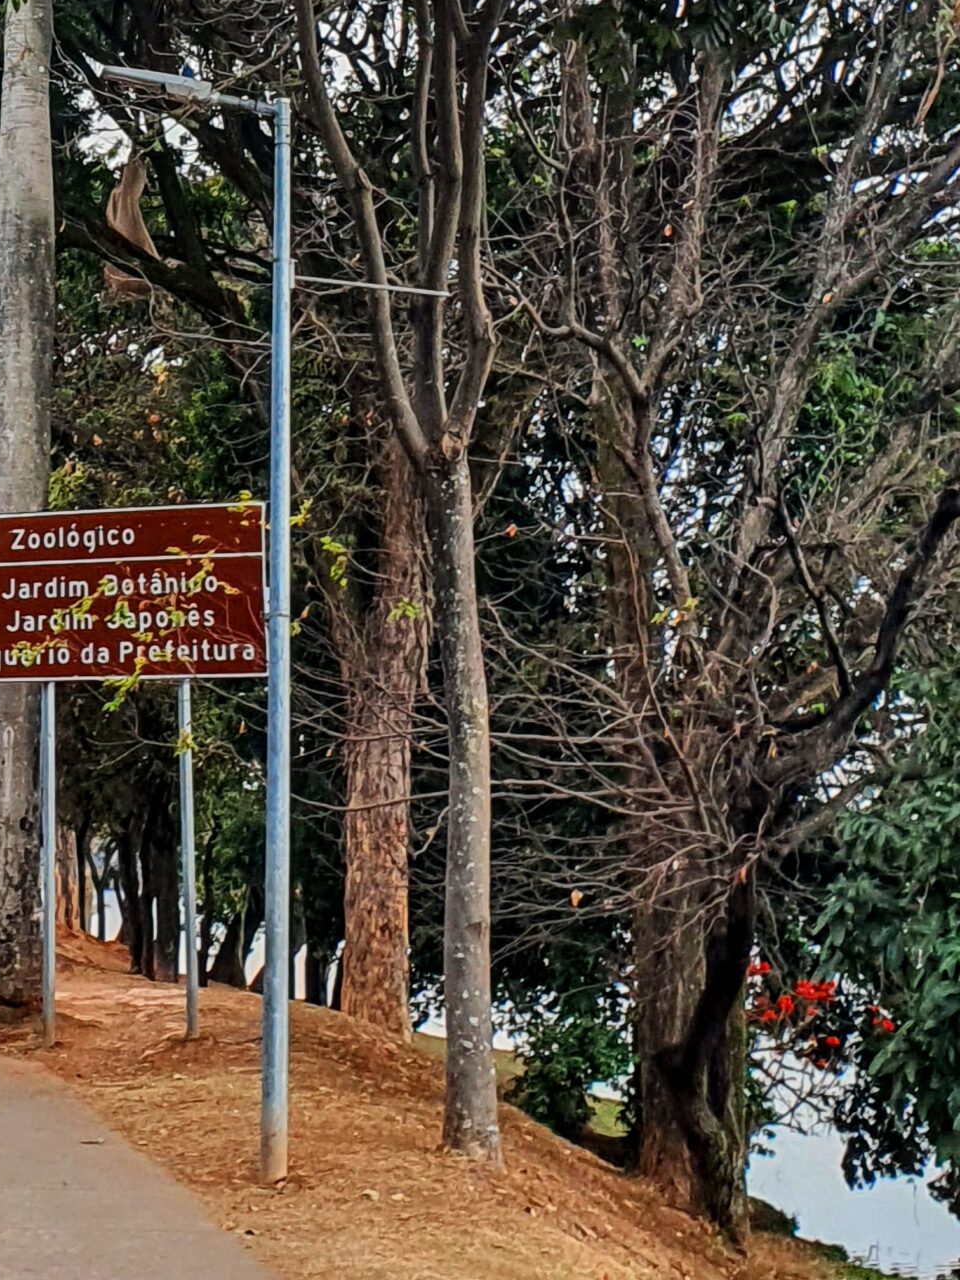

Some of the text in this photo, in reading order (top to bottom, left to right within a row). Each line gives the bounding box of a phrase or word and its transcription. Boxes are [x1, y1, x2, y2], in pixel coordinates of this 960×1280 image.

[10, 523, 135, 553] Zoológico
[1, 576, 89, 600] Jardim
[80, 642, 110, 664] da
